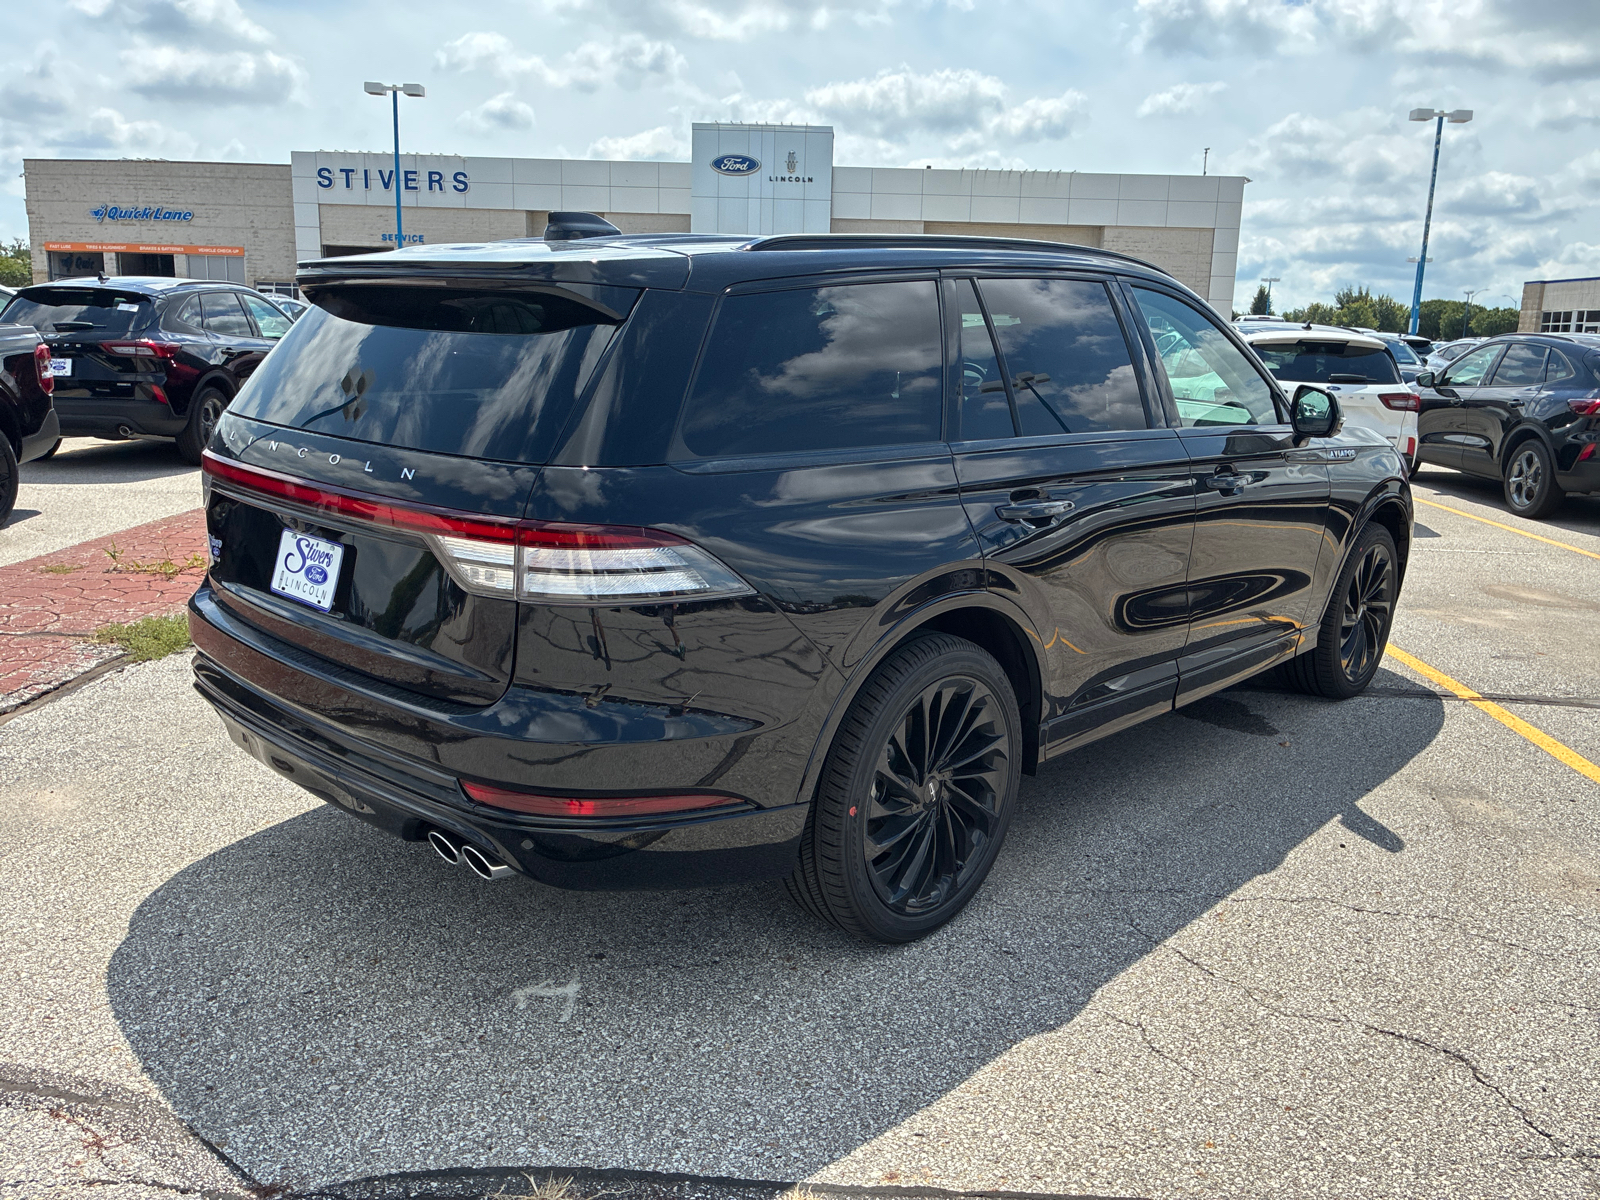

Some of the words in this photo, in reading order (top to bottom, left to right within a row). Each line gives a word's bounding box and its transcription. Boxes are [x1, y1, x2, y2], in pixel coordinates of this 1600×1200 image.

[720, 158, 749, 171] Ford
[317, 167, 470, 193] STIVERS
[229, 431, 416, 480] LINCOLN
[284, 537, 333, 573] Stivers
[308, 566, 324, 582] Ford
[285, 577, 327, 600] LINCOLN
